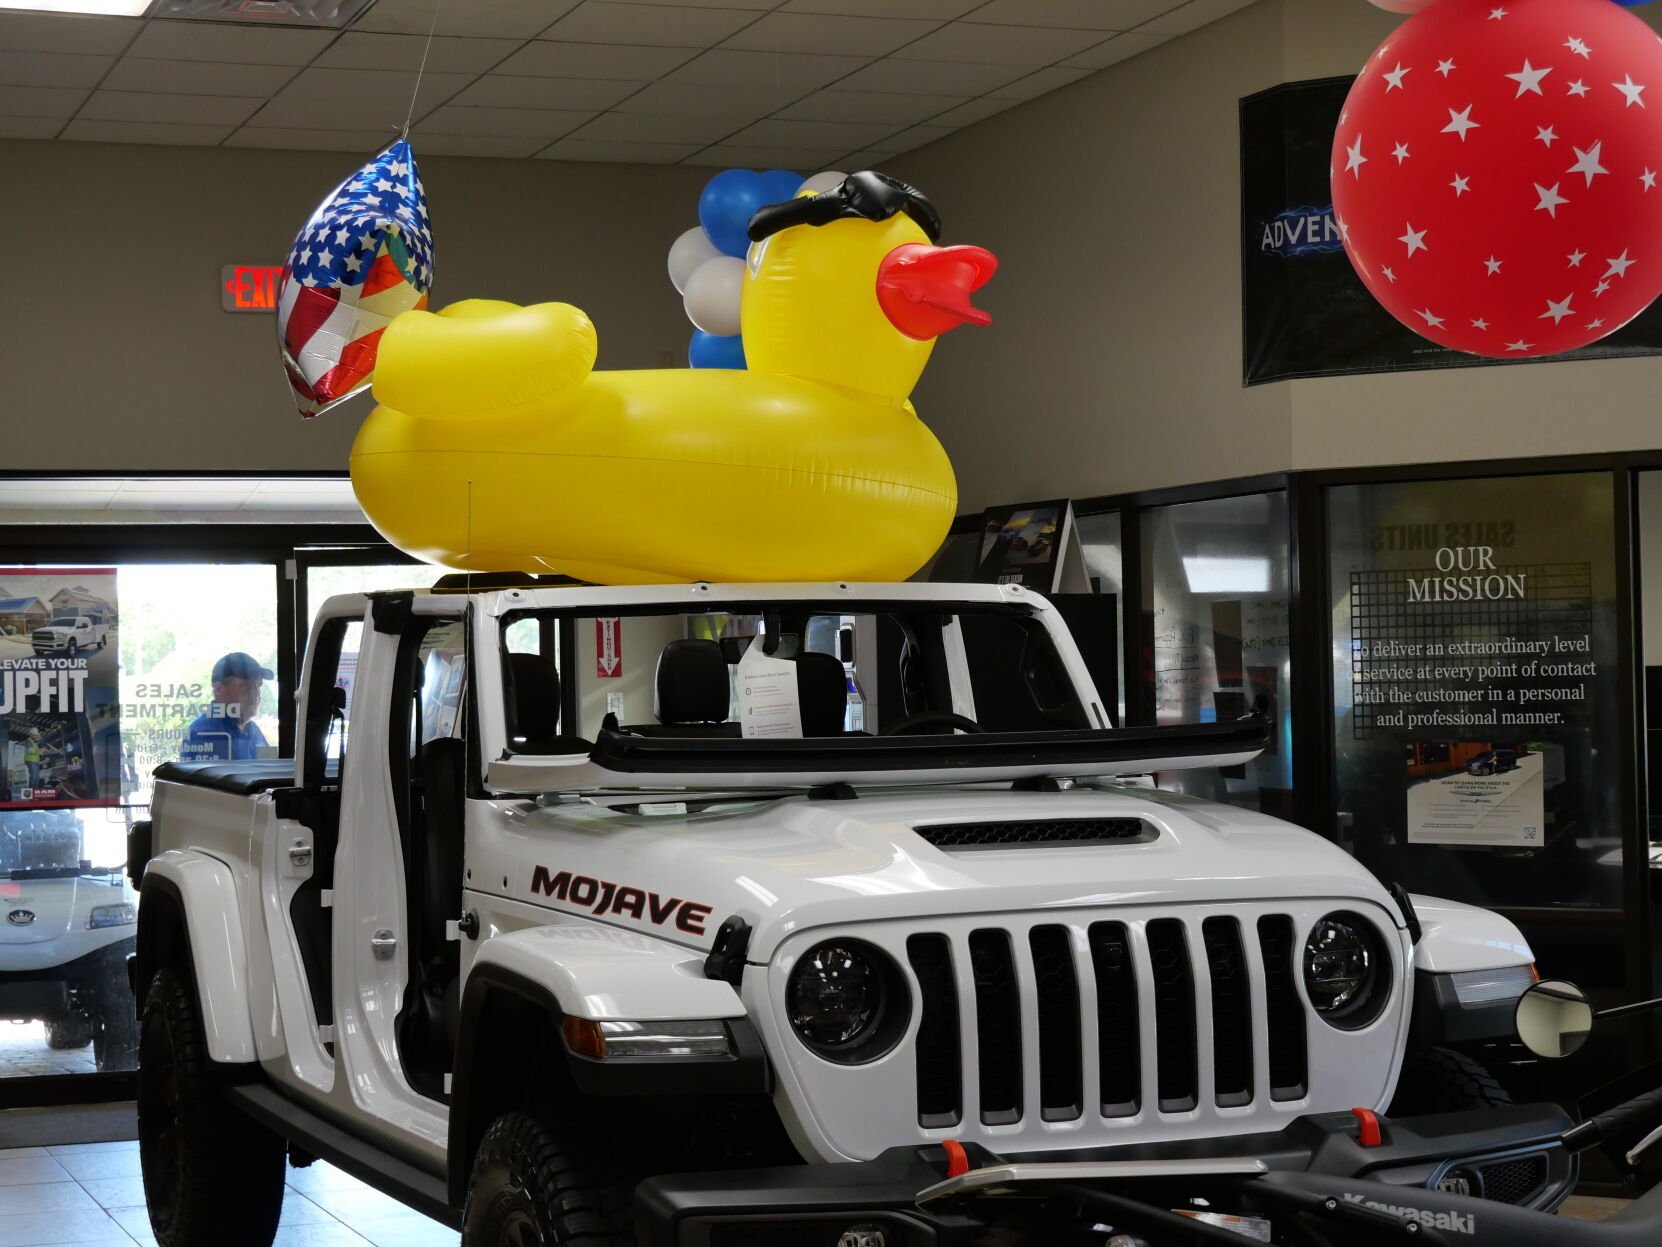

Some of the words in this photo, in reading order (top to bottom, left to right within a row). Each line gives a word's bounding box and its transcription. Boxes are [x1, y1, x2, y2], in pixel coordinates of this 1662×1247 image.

[1435, 546, 1496, 572] OUR
[1407, 574, 1526, 602] MISSION
[1374, 641, 1421, 657] deliver
[1426, 643, 1444, 656] an
[1448, 637, 1551, 656] extraordinary
[1554, 635, 1590, 652] level
[0, 659, 47, 669] EVATE
[50, 658, 87, 669] YOUR
[1363, 664, 1413, 681] service
[1417, 666, 1430, 679] at
[1434, 665, 1473, 682] every
[1478, 663, 1517, 682] point
[1521, 661, 1538, 677] of
[1540, 661, 1596, 677] contact
[1388, 686, 1412, 703] the
[1415, 688, 1484, 702] customer
[1488, 685, 1502, 701] in
[1506, 689, 1516, 700] a
[1519, 684, 1585, 704] personal
[1376, 709, 1404, 726] and
[1407, 709, 1497, 729] professional
[1502, 711, 1565, 725] manner.
[530, 865, 713, 936] MOJAVE
